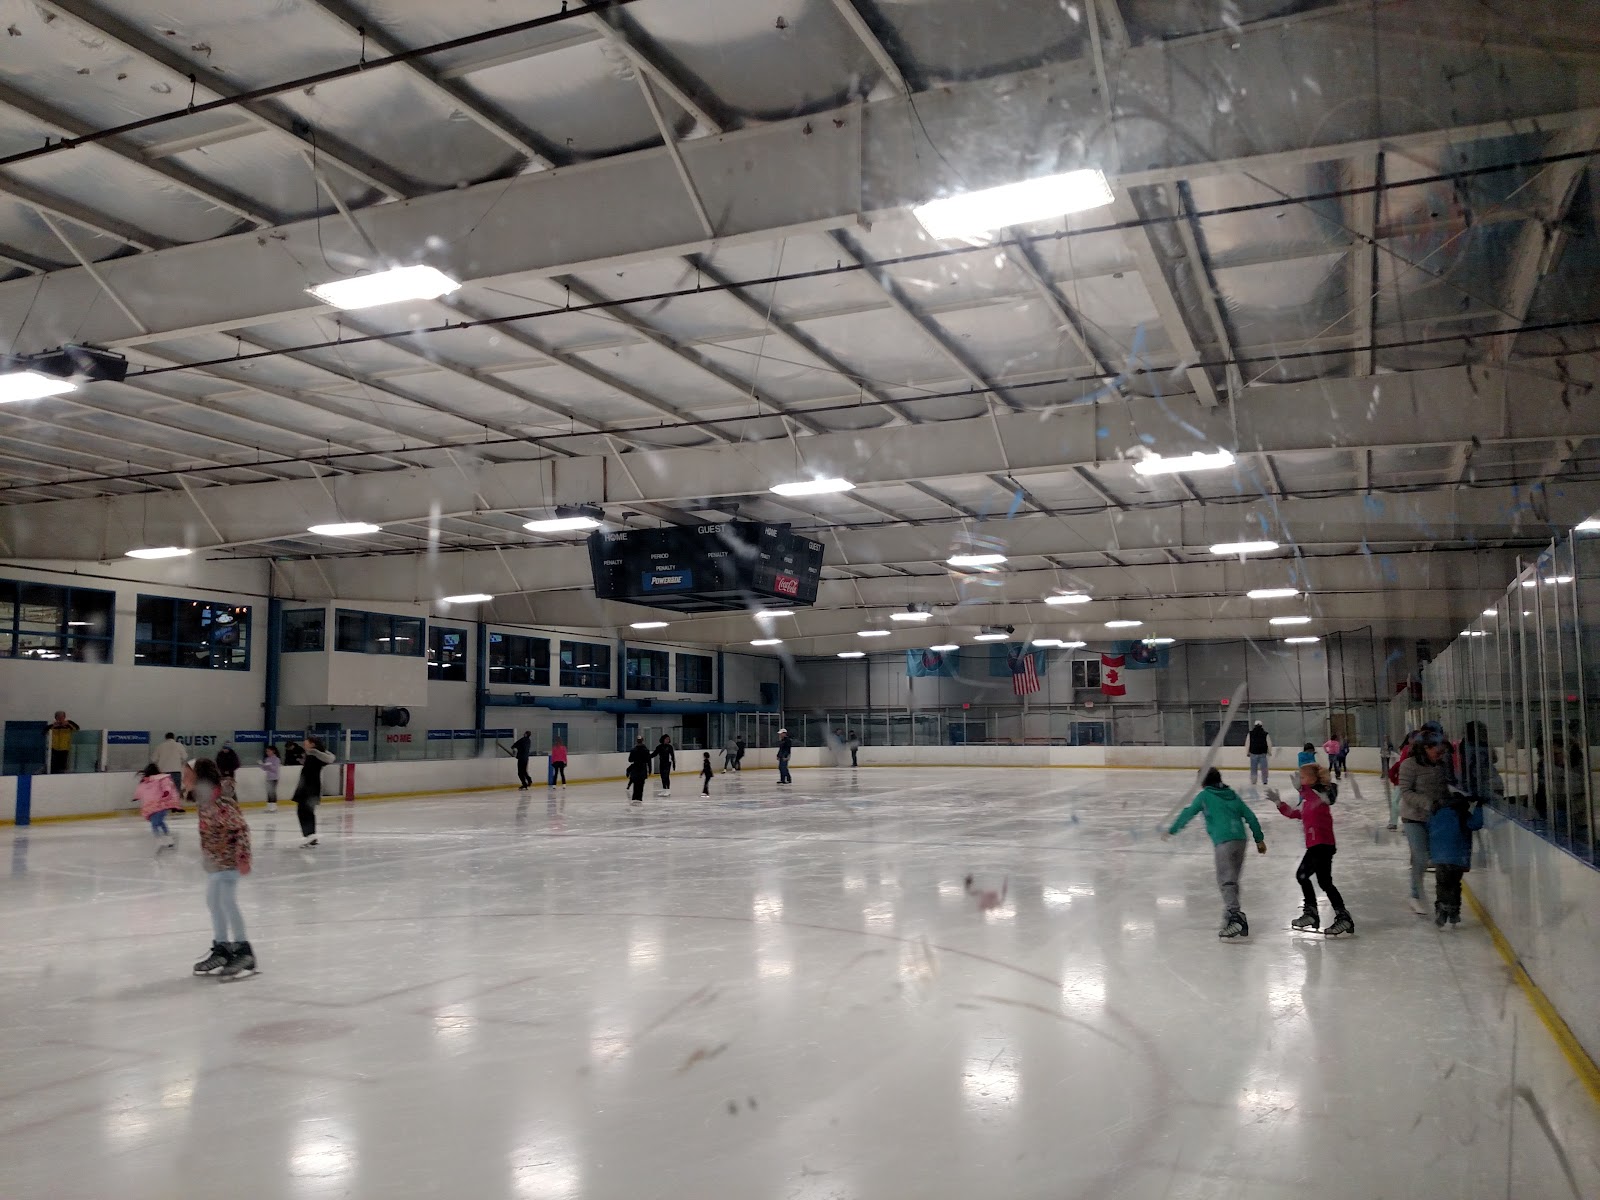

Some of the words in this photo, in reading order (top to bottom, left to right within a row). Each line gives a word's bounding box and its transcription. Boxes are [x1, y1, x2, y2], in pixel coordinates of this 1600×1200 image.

[697, 525, 726, 534] GUEST
[604, 532, 628, 542] HOME
[176, 735, 217, 746] GUEST
[386, 733, 412, 743] HOME
